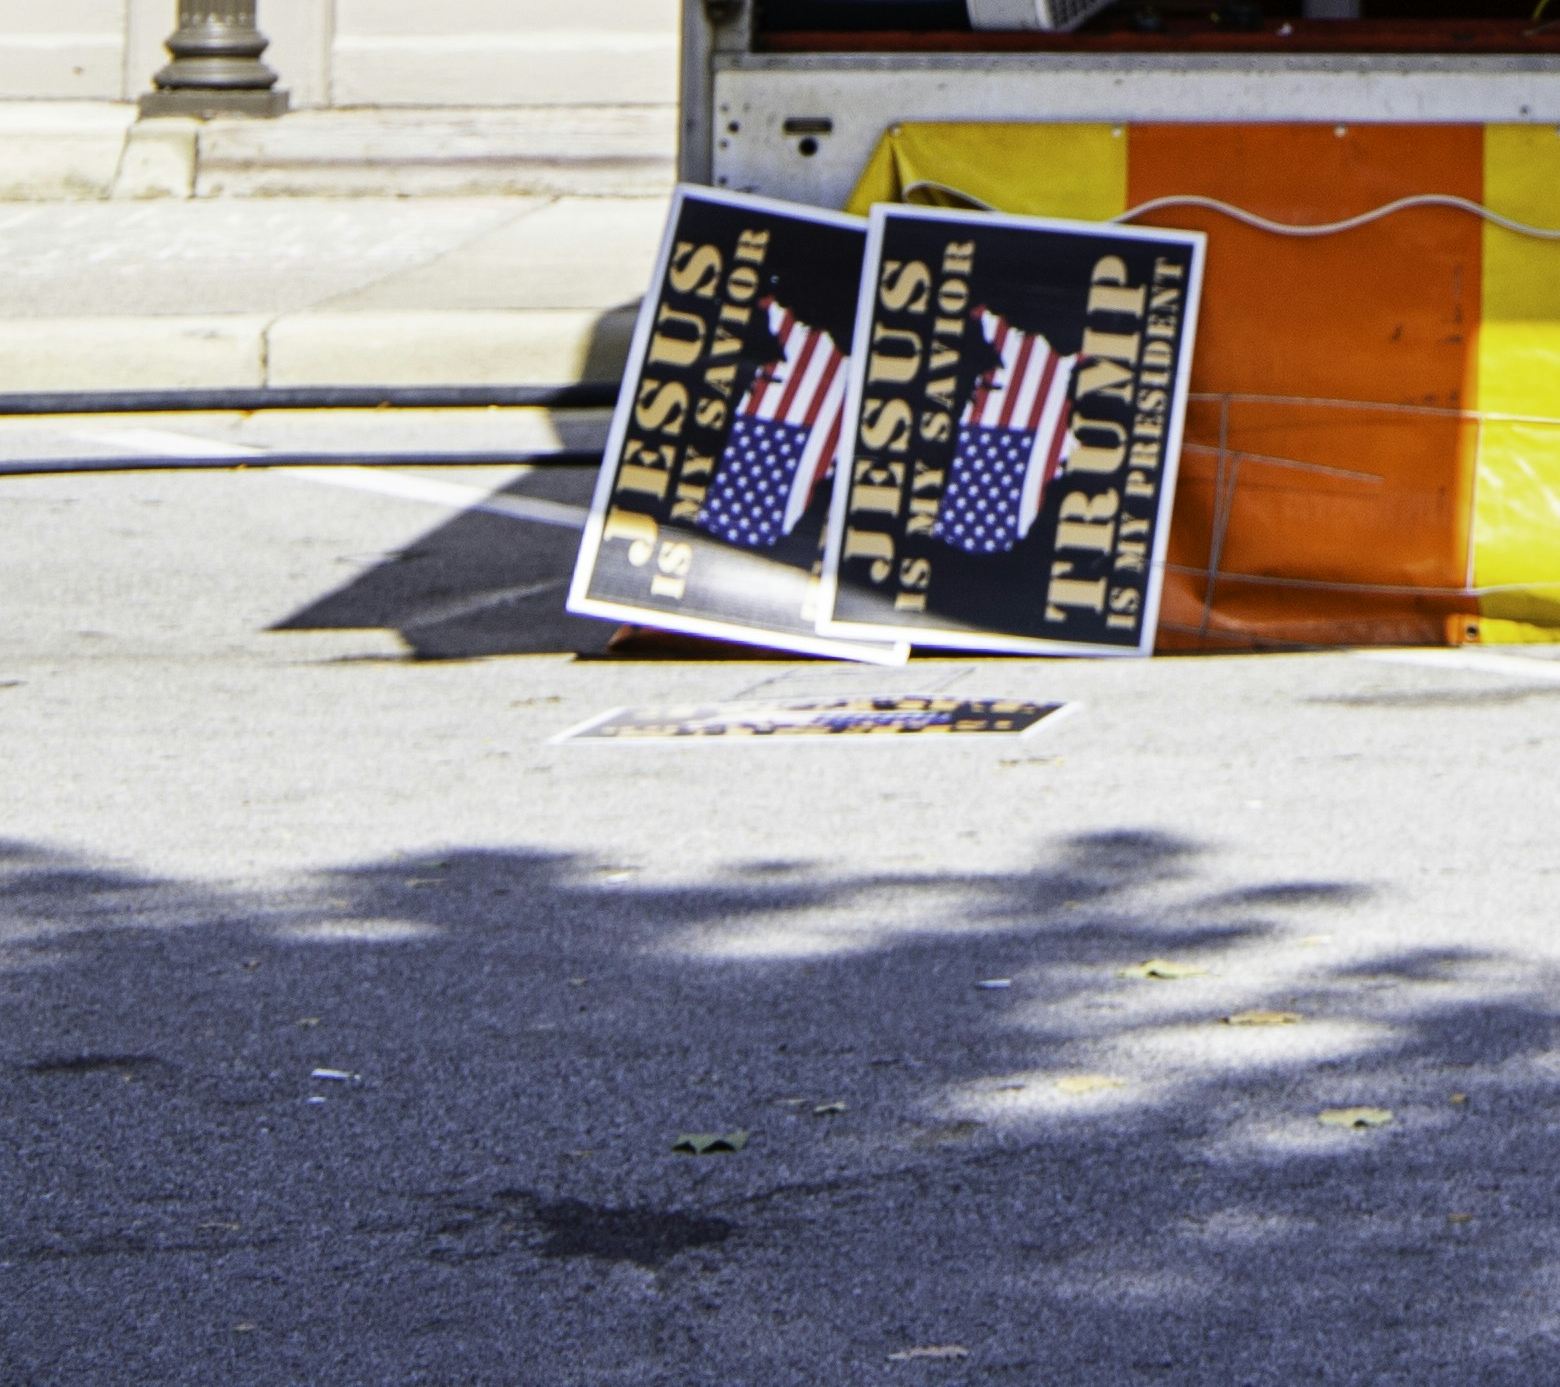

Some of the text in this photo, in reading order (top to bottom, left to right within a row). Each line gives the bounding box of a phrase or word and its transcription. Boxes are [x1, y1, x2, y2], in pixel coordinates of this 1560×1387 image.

[602, 241, 723, 568] JESUS
[650, 228, 771, 600] IS MY SAVIOR
[843, 259, 932, 585] JESUS
[894, 239, 976, 613] IS MY SAVIOR
[1044, 254, 1147, 622] TRUMP
[1106, 256, 1185, 628] IS MY PRESIDENT
